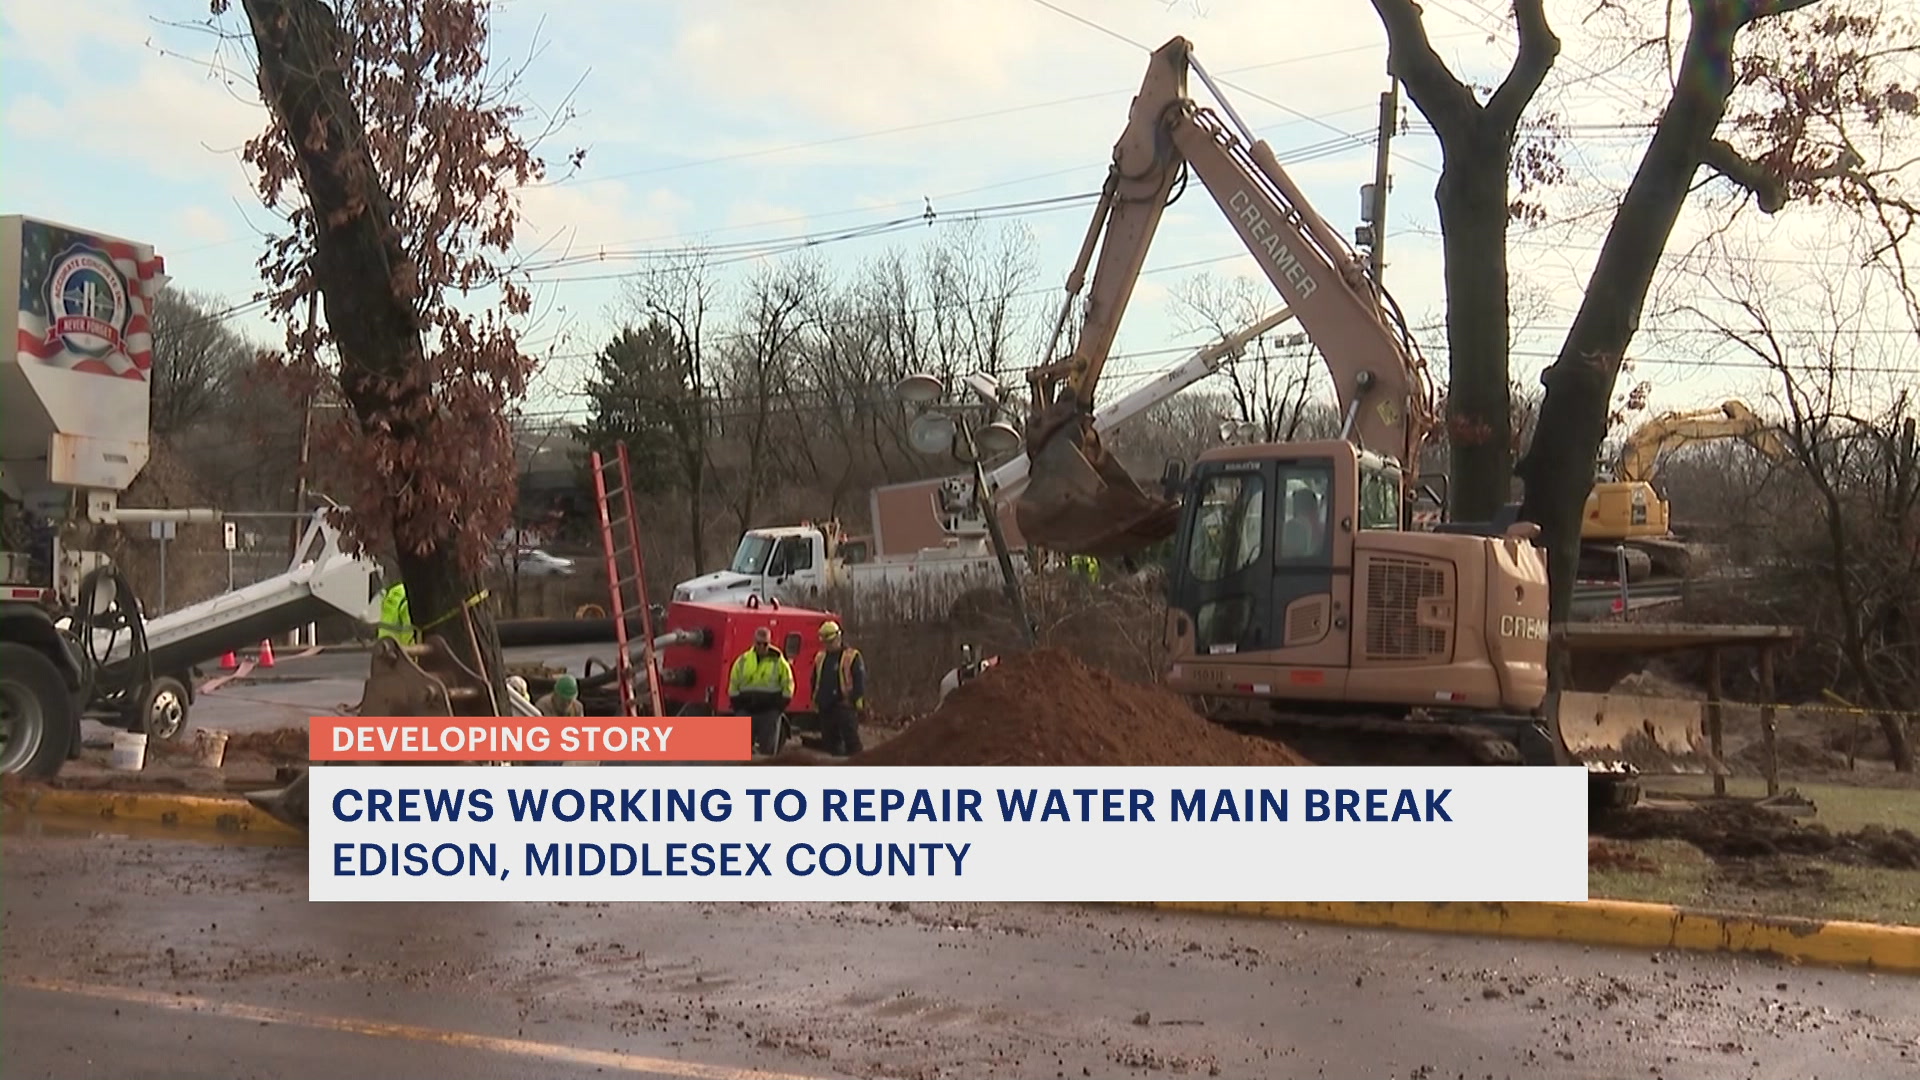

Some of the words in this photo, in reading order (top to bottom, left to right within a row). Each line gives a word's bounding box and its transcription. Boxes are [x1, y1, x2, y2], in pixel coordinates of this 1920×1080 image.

[1229, 190, 1318, 299] CREAMER
[63, 319, 86, 332] NEVER
[87, 320, 113, 338] FORGET
